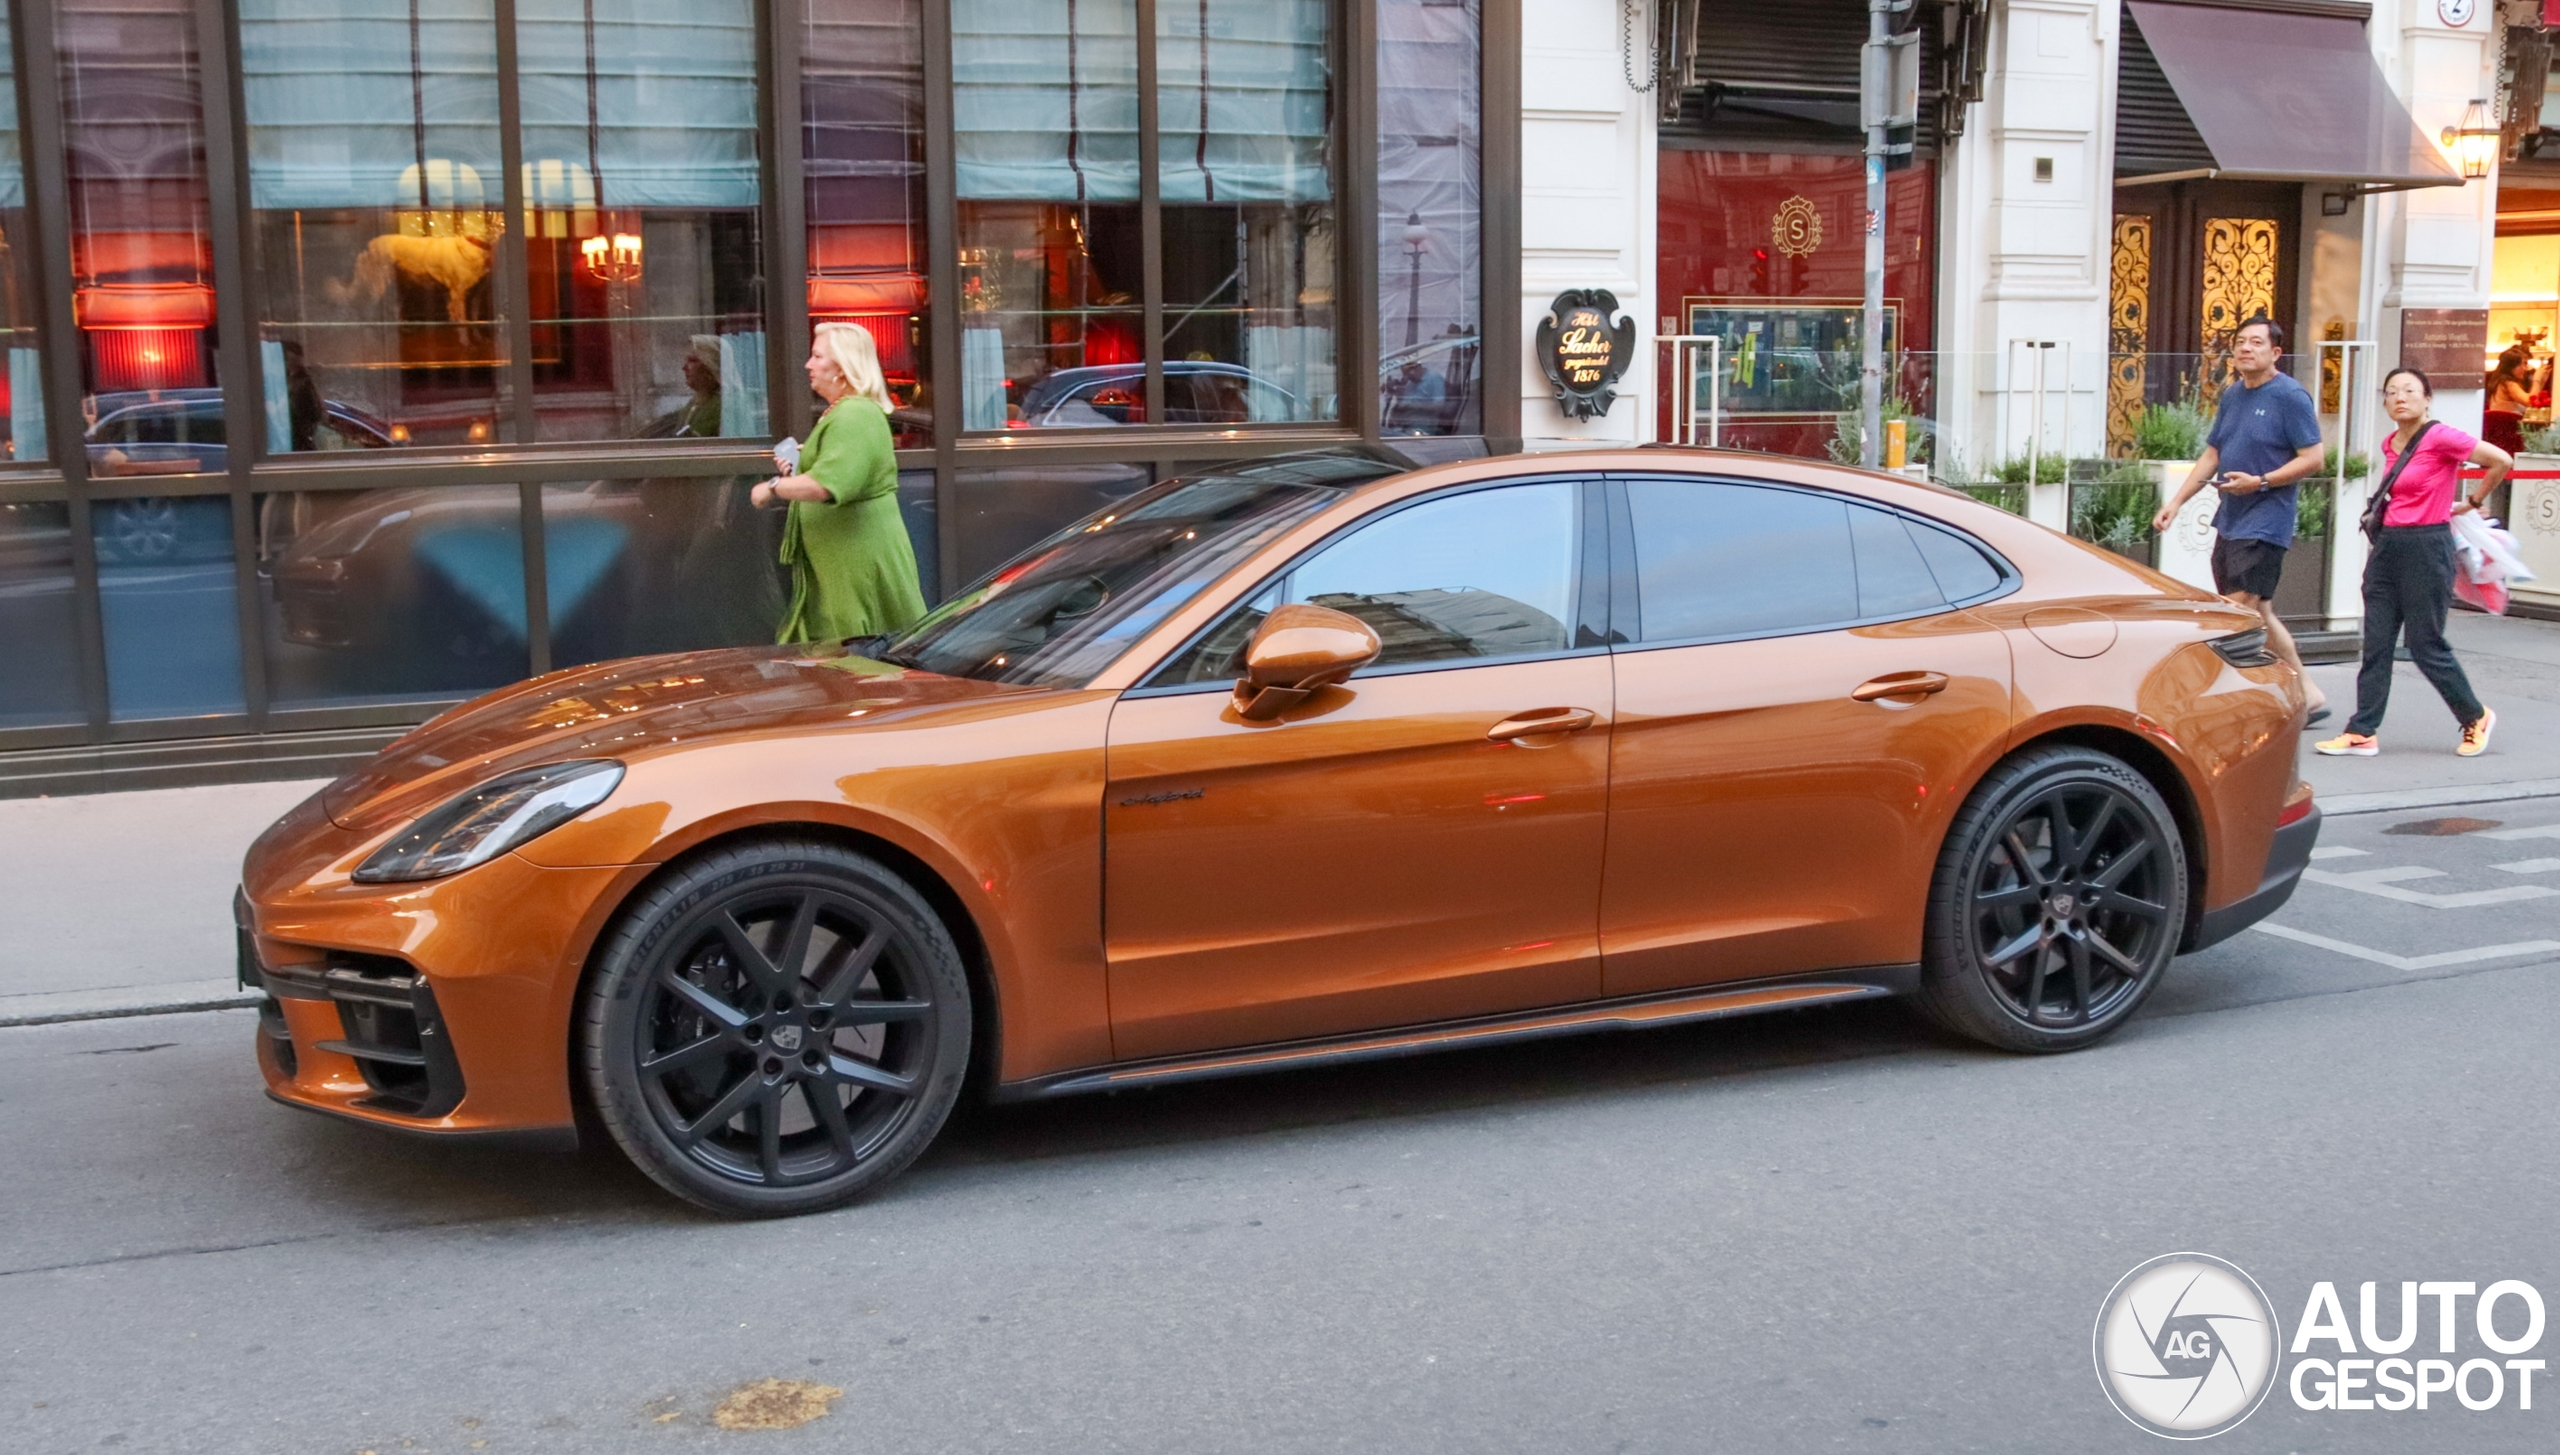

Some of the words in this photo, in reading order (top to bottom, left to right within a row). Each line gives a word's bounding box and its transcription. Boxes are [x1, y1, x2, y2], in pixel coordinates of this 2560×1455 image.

[1791, 219, 1804, 240] S
[1559, 327, 1612, 354] Sacher
[1573, 369, 1601, 382] 1876
[2541, 499, 2554, 519] S
[2197, 513, 2210, 536] S
[631, 891, 700, 972] MICHELIN
